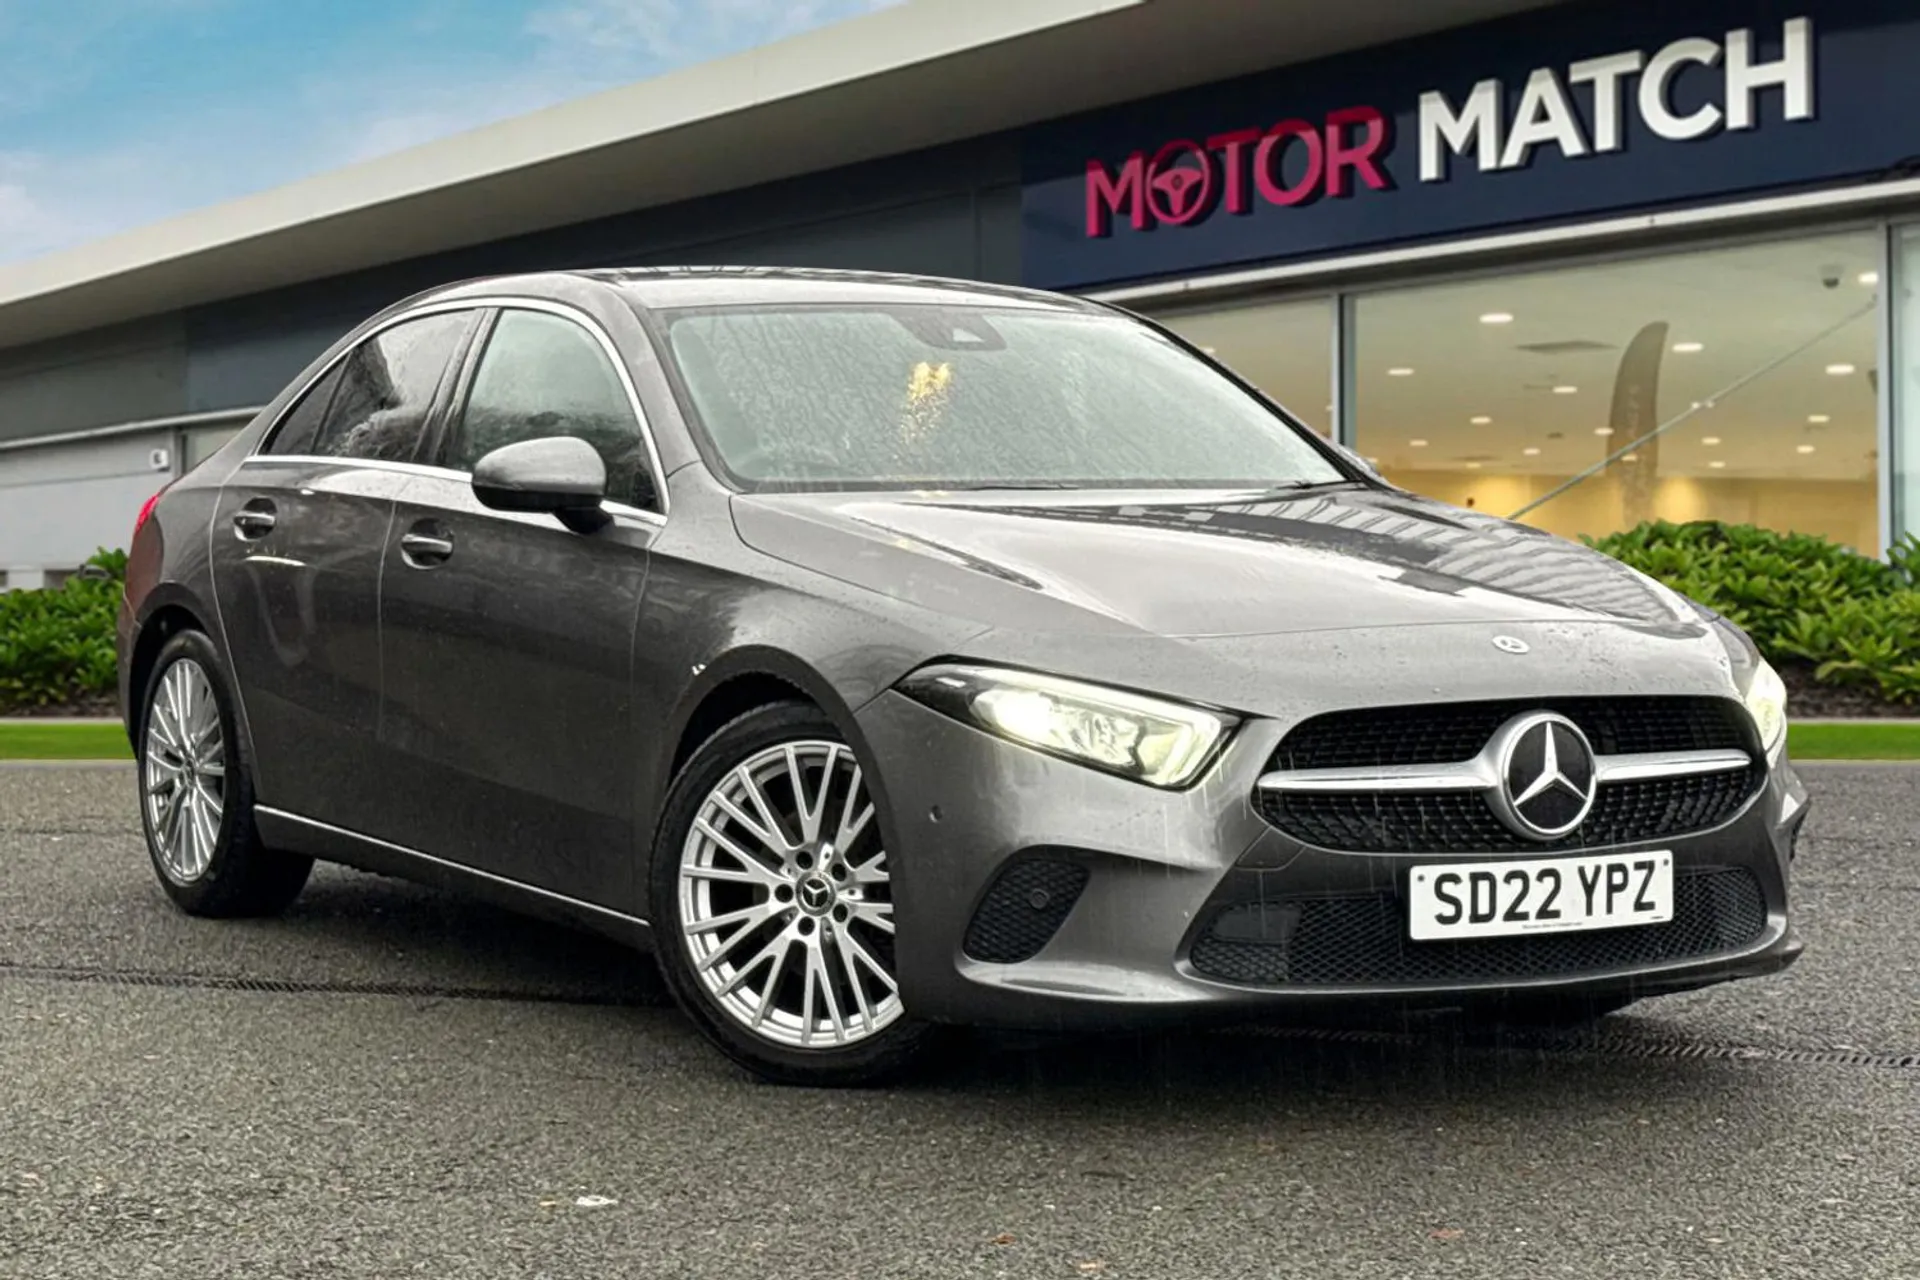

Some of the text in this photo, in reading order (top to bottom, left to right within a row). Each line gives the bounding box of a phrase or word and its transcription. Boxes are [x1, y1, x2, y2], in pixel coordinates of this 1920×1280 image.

[1086, 17, 1814, 239] MOTOR MATCH
[1434, 860, 1656, 926] SD22 YPZ
